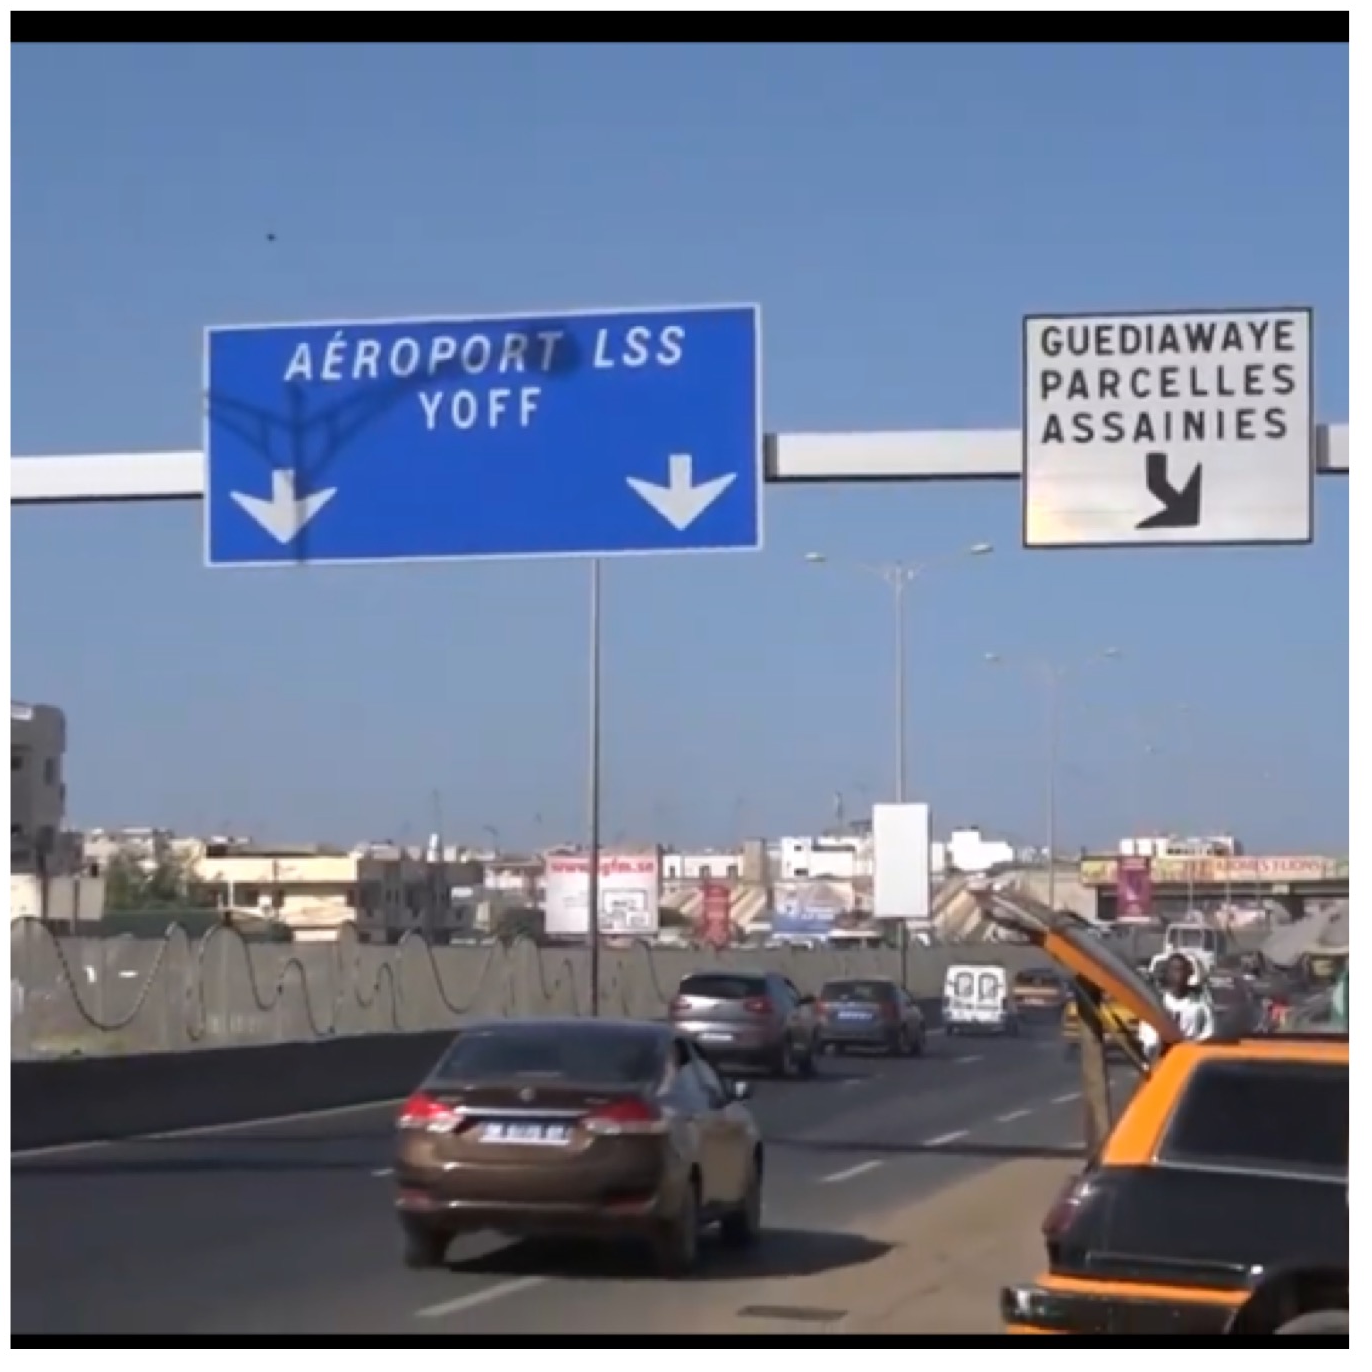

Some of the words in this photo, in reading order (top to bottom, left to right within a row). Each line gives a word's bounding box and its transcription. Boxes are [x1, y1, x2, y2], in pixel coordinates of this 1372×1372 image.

[284, 331, 564, 382] AÉROPORT
[592, 326, 686, 369] LSS
[1040, 320, 1295, 357] GUEDIAWAYE
[1040, 364, 1295, 401] PARCELLES
[418, 387, 542, 429] YOFF
[1041, 407, 1287, 444] ASSAINIES
